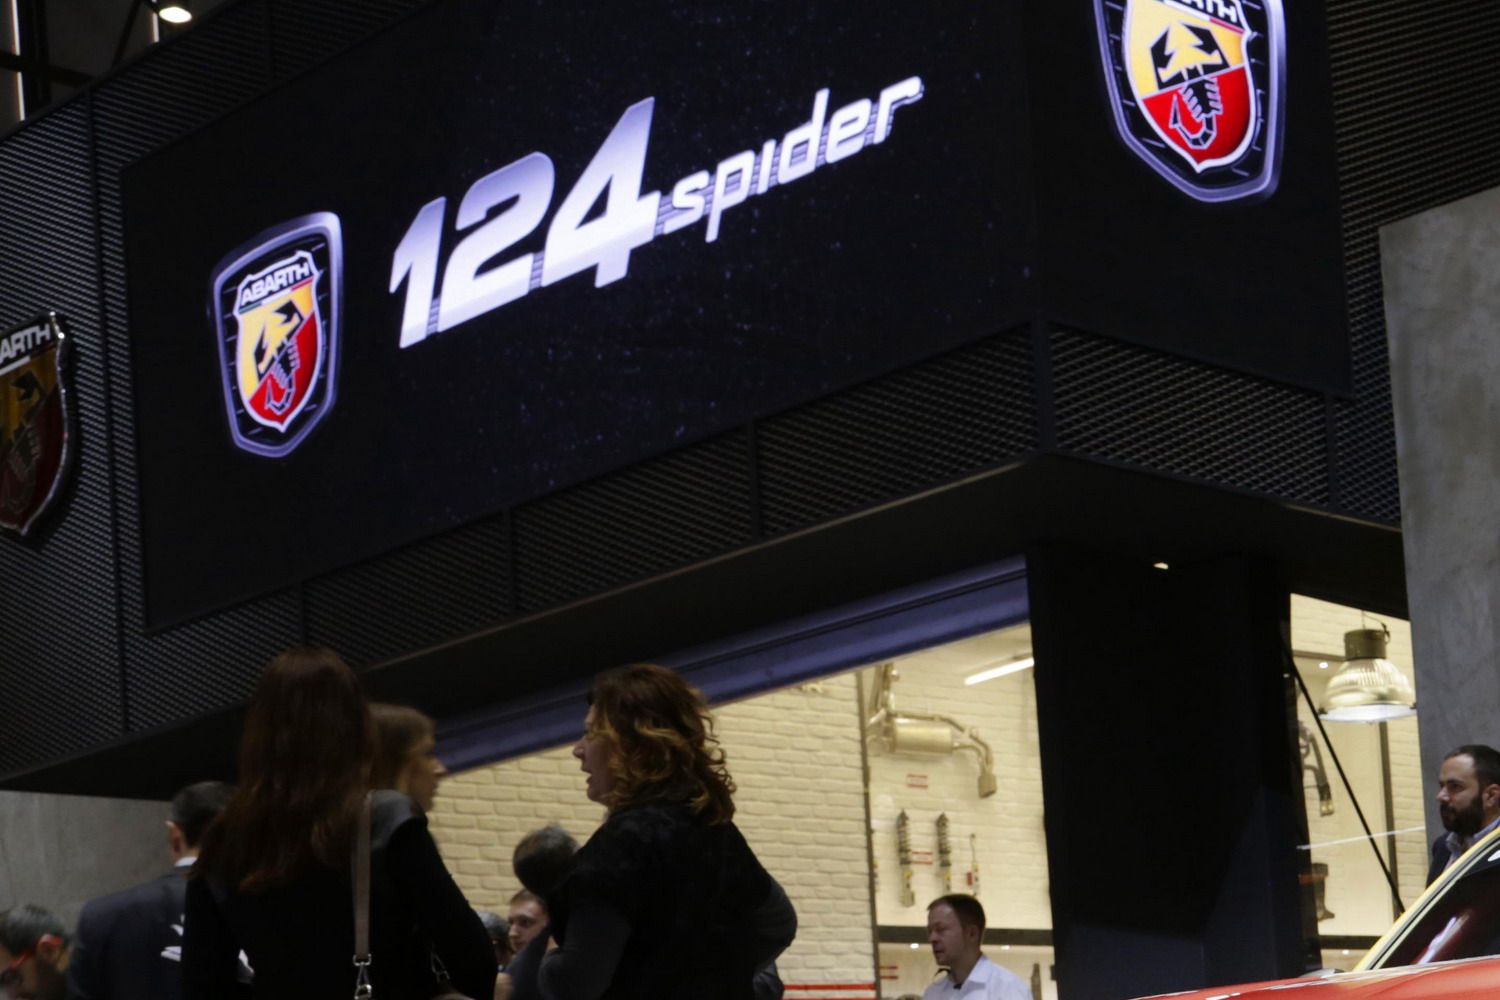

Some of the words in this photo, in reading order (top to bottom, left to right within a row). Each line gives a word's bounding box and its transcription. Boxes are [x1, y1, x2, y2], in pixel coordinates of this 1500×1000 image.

[240, 261, 310, 306] ABARTH
[389, 96, 660, 349] 124
[662, 75, 924, 243] spider
